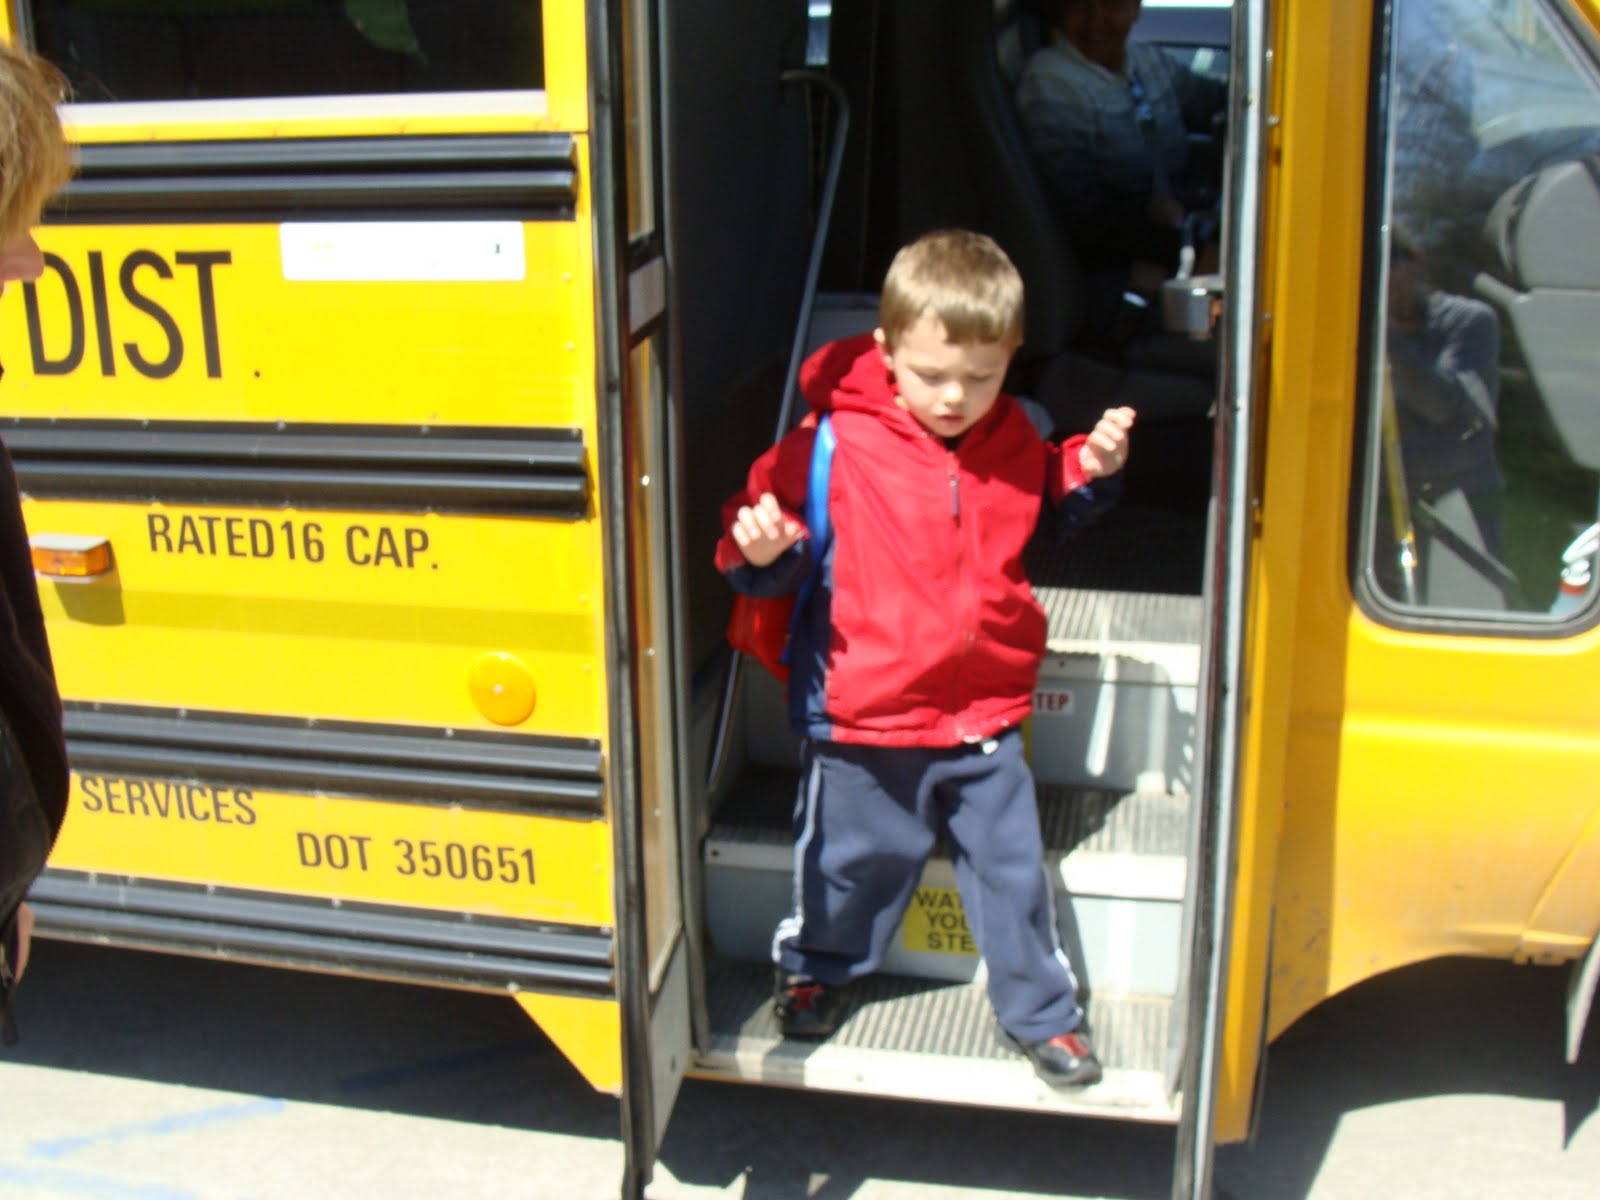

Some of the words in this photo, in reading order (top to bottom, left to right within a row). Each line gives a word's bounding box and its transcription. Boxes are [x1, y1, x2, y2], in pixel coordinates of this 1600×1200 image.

[21, 249, 232, 379] DIST
[345, 524, 438, 570] CAP.
[1035, 692, 1069, 711] TEP
[79, 774, 257, 826] SERVICES
[296, 832, 372, 871] DOT
[394, 839, 536, 885] 350651
[927, 932, 977, 952] STE
